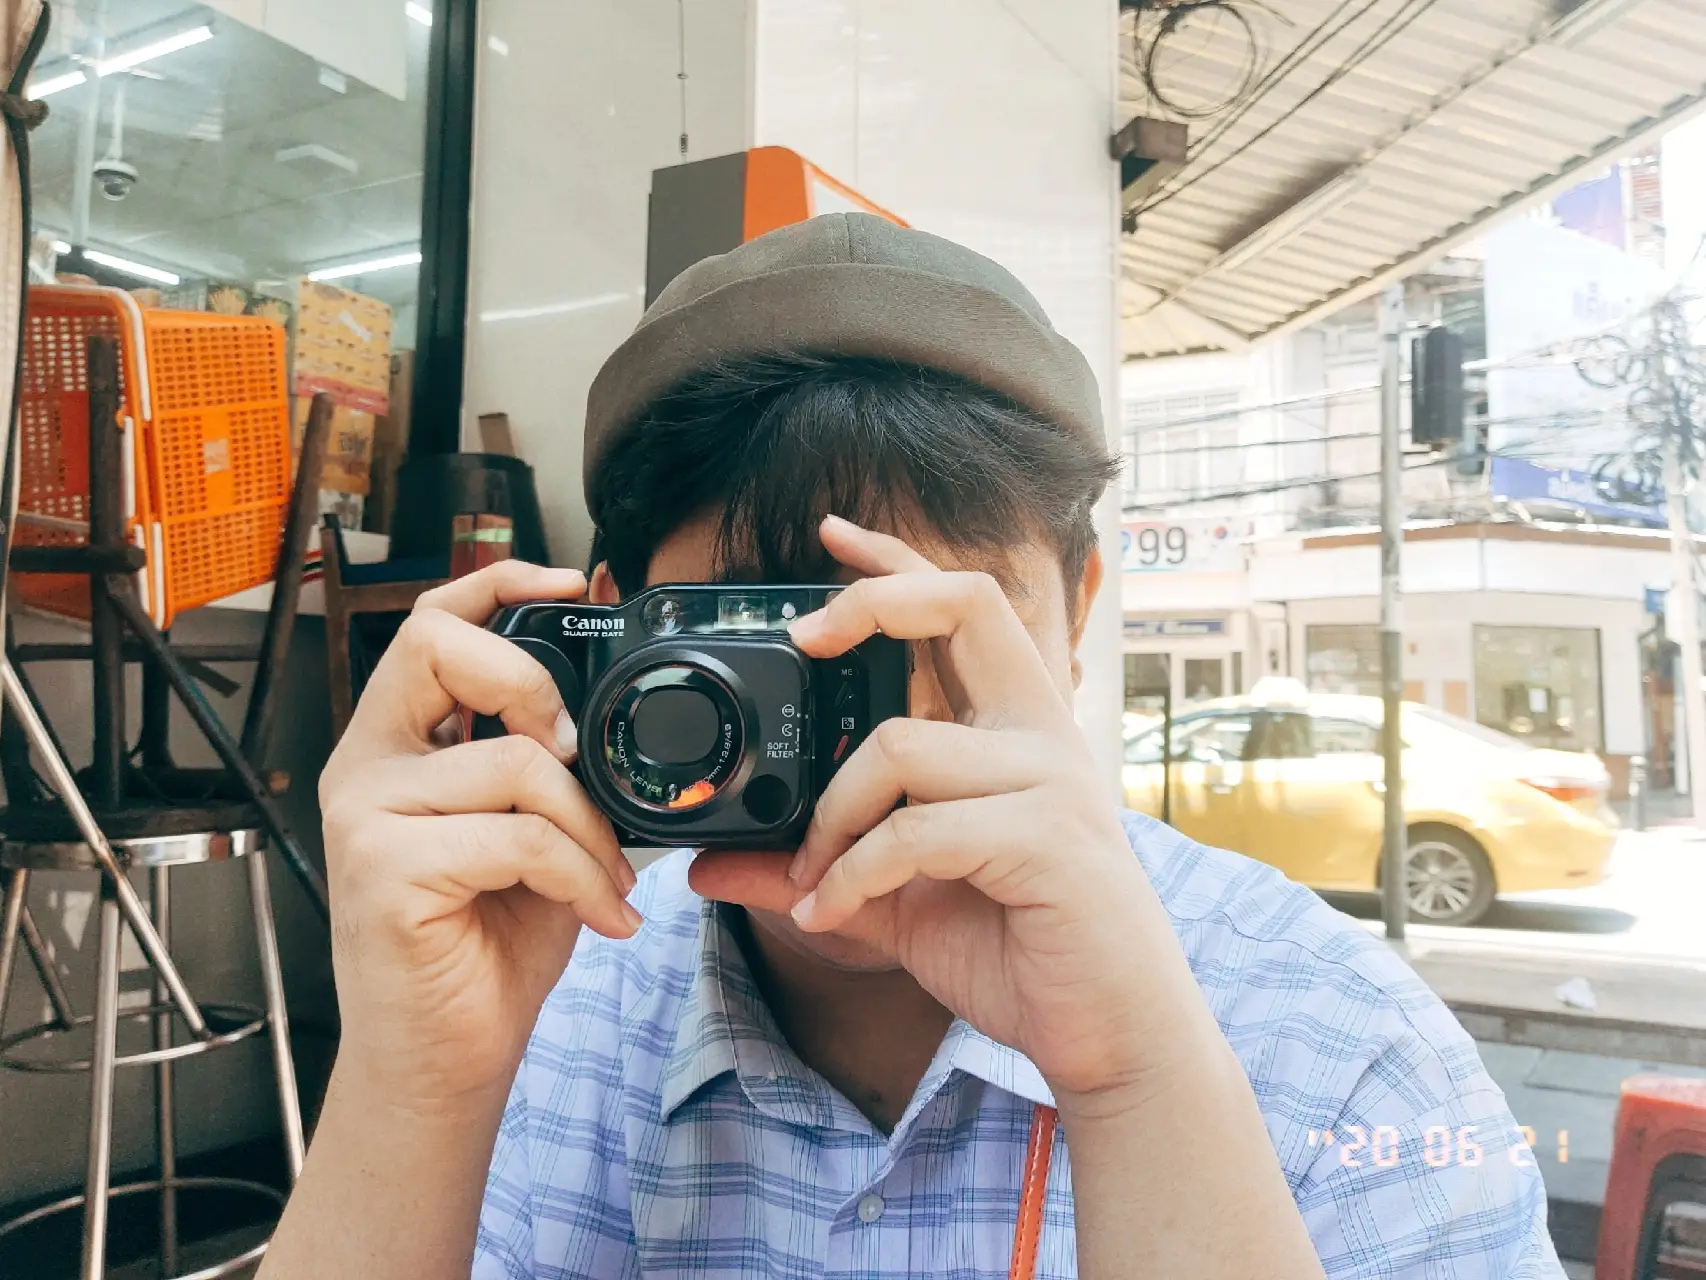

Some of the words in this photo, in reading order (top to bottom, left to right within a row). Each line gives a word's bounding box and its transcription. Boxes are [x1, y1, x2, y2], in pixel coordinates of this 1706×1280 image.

[561, 615, 625, 630] Canon
[562, 630, 599, 638] QUARTZ
[767, 742, 790, 750] SOFT
[616, 721, 630, 768] CANON
[629, 770, 660, 793] LENS
[767, 750, 794, 759] FILTER
